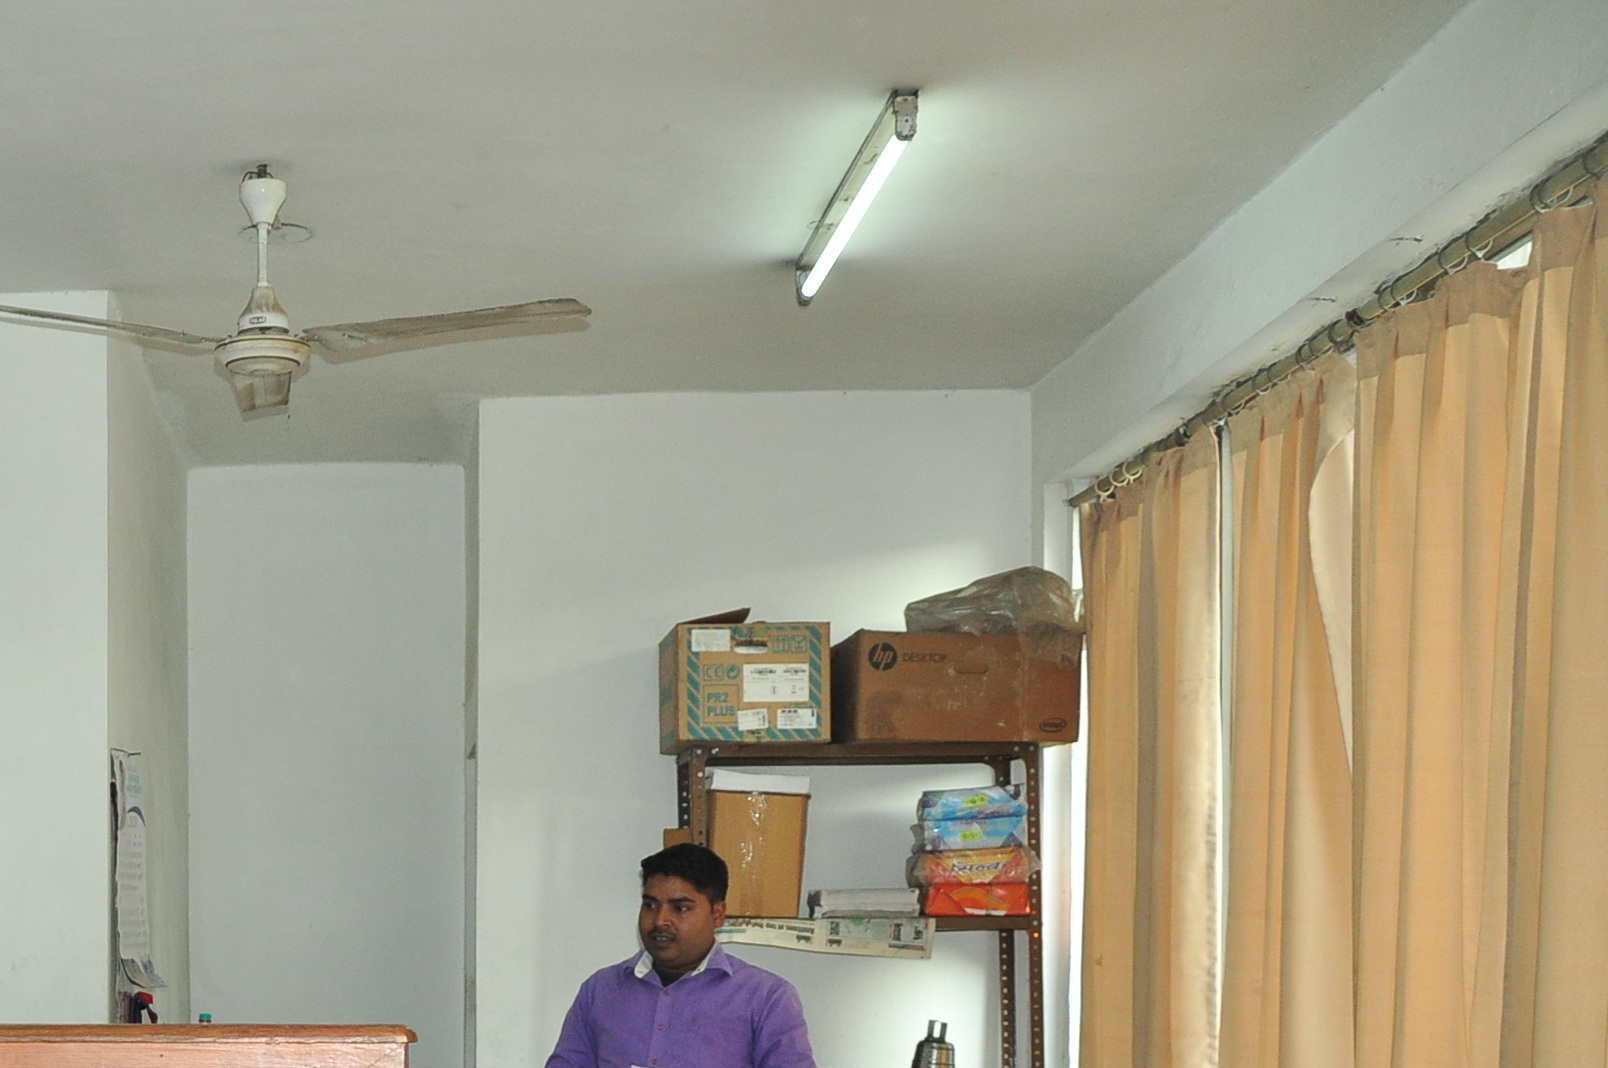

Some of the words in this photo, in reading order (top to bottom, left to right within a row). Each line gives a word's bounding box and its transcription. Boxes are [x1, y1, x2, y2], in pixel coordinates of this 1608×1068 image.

[871, 642, 895, 671] hp
[707, 692, 729, 703] PR2
[706, 706, 735, 717] PLUS
